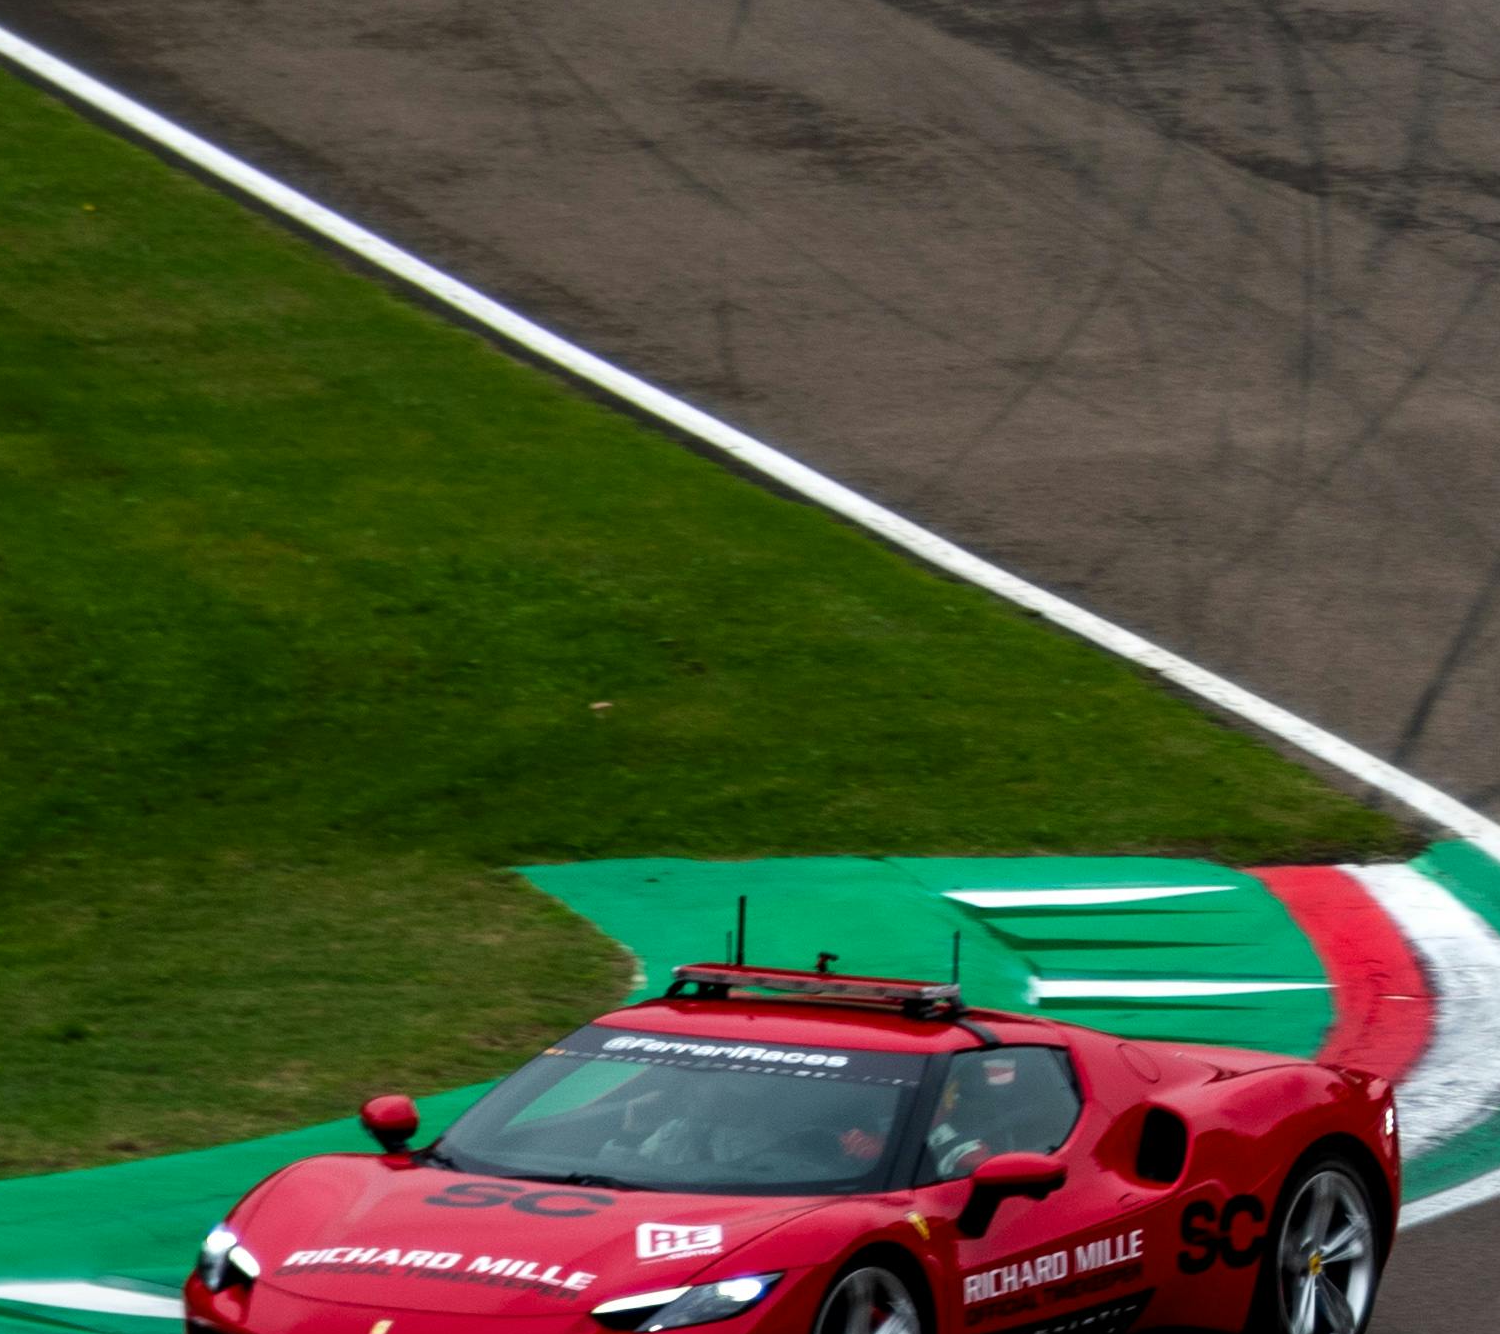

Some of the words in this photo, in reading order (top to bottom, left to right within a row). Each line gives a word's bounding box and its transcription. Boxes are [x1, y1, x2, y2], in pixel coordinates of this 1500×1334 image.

[422, 1181, 616, 1218] SC
[1177, 1194, 1266, 1275] SC
[283, 1247, 464, 1270] RICHARD
[465, 1255, 598, 1292] MILLE
[963, 1260, 1067, 1304] RICHARD
[1075, 1229, 1144, 1273] MILLE
